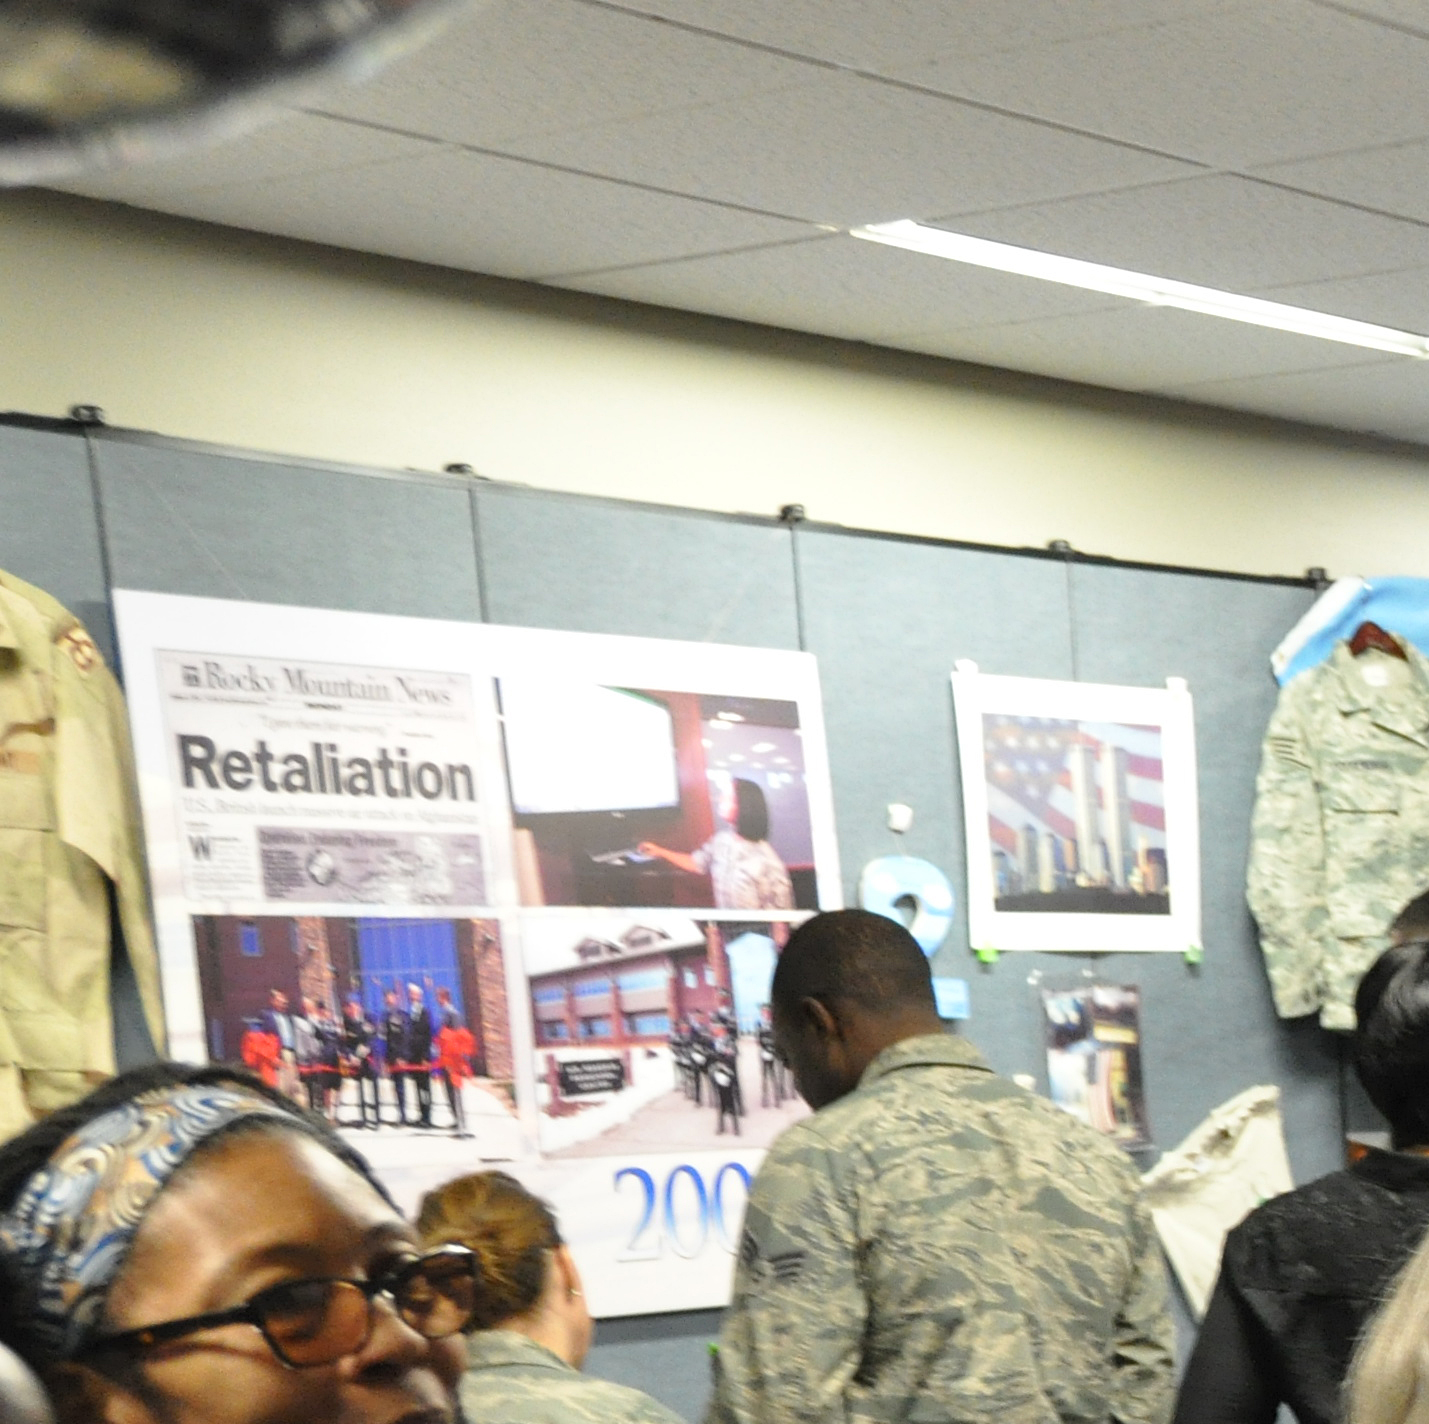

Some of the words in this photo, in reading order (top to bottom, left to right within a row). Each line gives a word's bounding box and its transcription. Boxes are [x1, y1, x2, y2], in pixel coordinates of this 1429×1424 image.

[282, 666, 394, 701] Mountain
[396, 676, 453, 705] News
[176, 733, 477, 802] Retaliation
